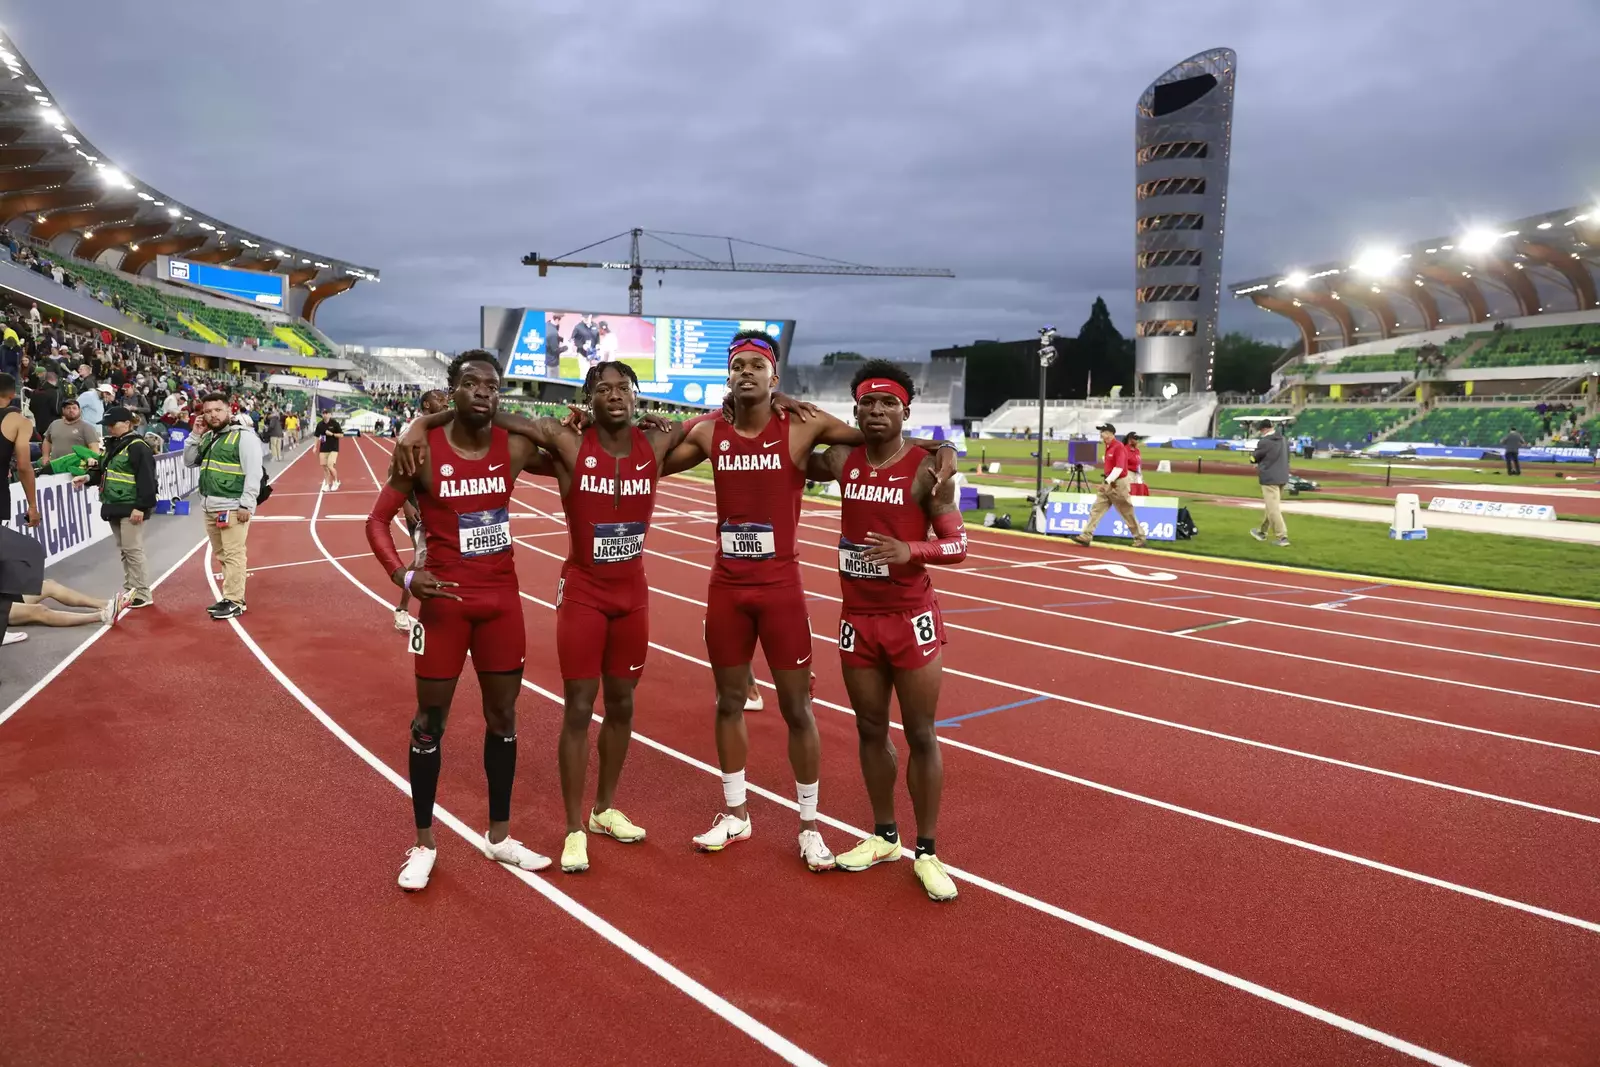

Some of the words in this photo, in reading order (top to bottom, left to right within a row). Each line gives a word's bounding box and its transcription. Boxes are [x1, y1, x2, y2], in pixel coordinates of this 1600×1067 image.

[717, 454, 782, 471] ALABAMA
[439, 477, 507, 498] ALABAMA
[579, 474, 652, 496] ALABAMA
[844, 483, 904, 505] ALABAMA
[1432, 498, 1446, 507] 50
[1457, 501, 1472, 510] 52
[1487, 503, 1502, 512] 54
[1517, 505, 1533, 515] 56
[1411, 509, 1415, 529] 1
[472, 525, 502, 537] LEANDER
[735, 533, 758, 541] CORDE
[1112, 520, 1174, 538] 3:3.40
[466, 532, 508, 550] FORBES
[601, 536, 639, 546] DEMETRIUS
[732, 541, 762, 552] LONG
[594, 542, 643, 558] JACKSON
[845, 559, 883, 575] MCRAE
[842, 622, 853, 649] 8
[916, 615, 933, 642] 8
[411, 623, 423, 652] 8
